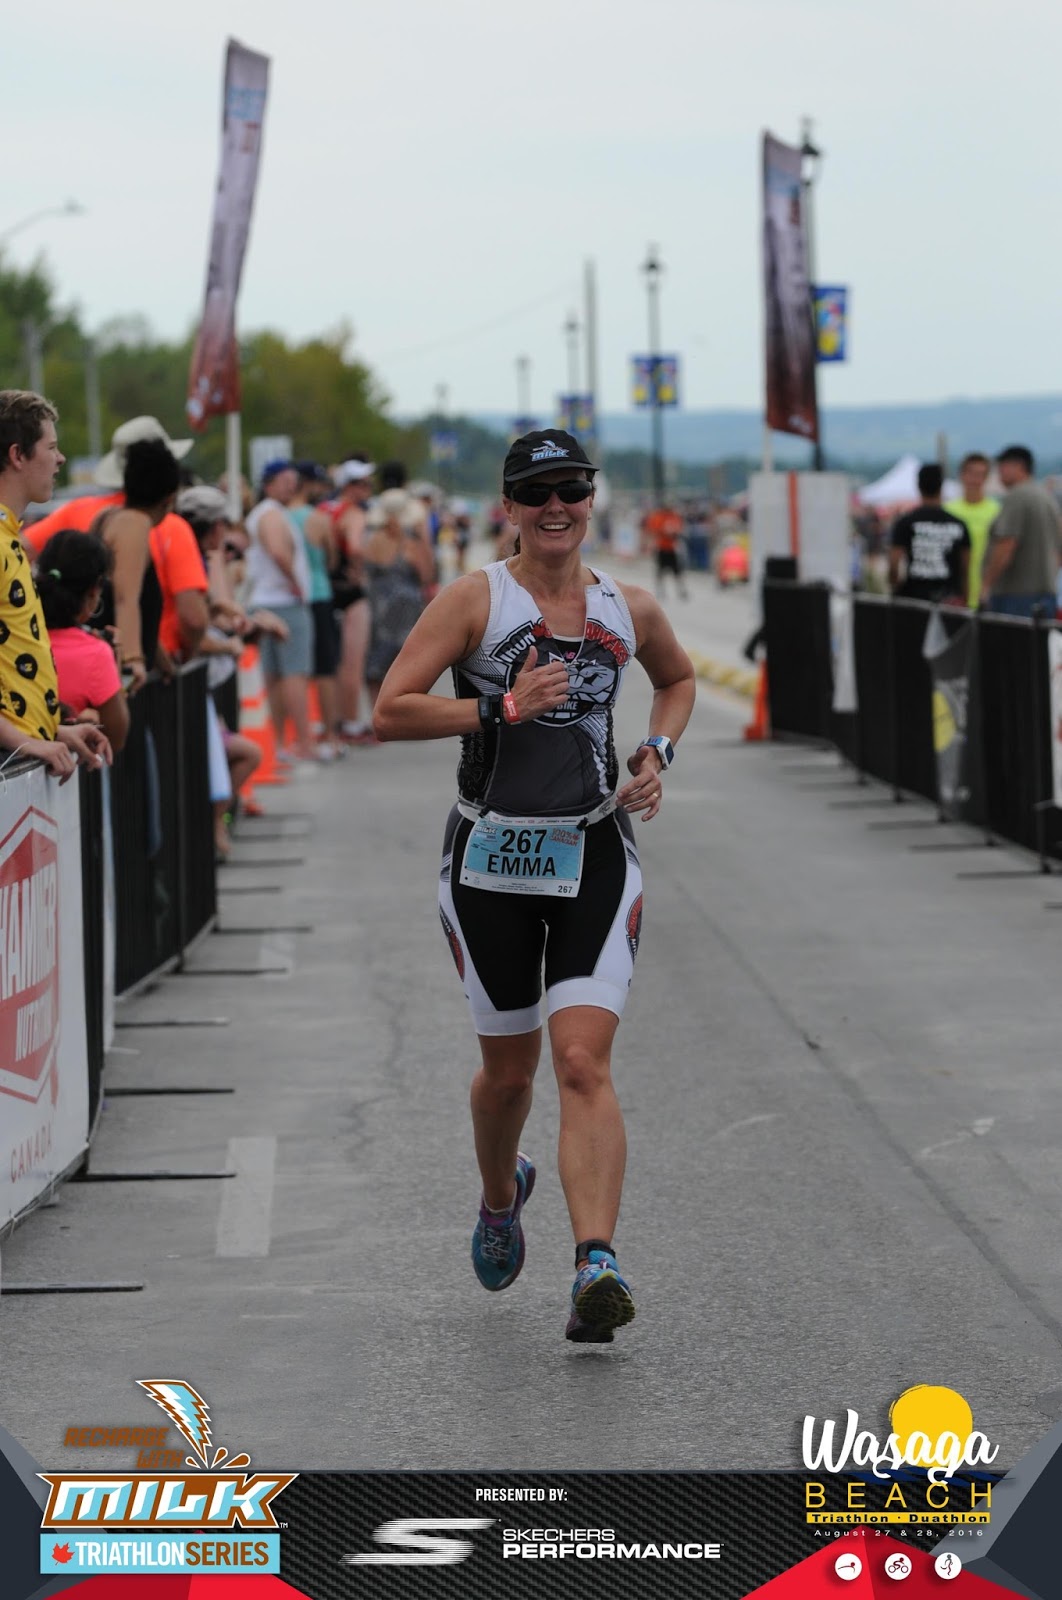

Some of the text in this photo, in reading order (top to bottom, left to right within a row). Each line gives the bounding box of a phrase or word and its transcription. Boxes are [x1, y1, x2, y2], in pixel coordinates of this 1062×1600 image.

[500, 828, 548, 854] 267
[487, 854, 556, 877] EMMA
[557, 885, 573, 894] 267
